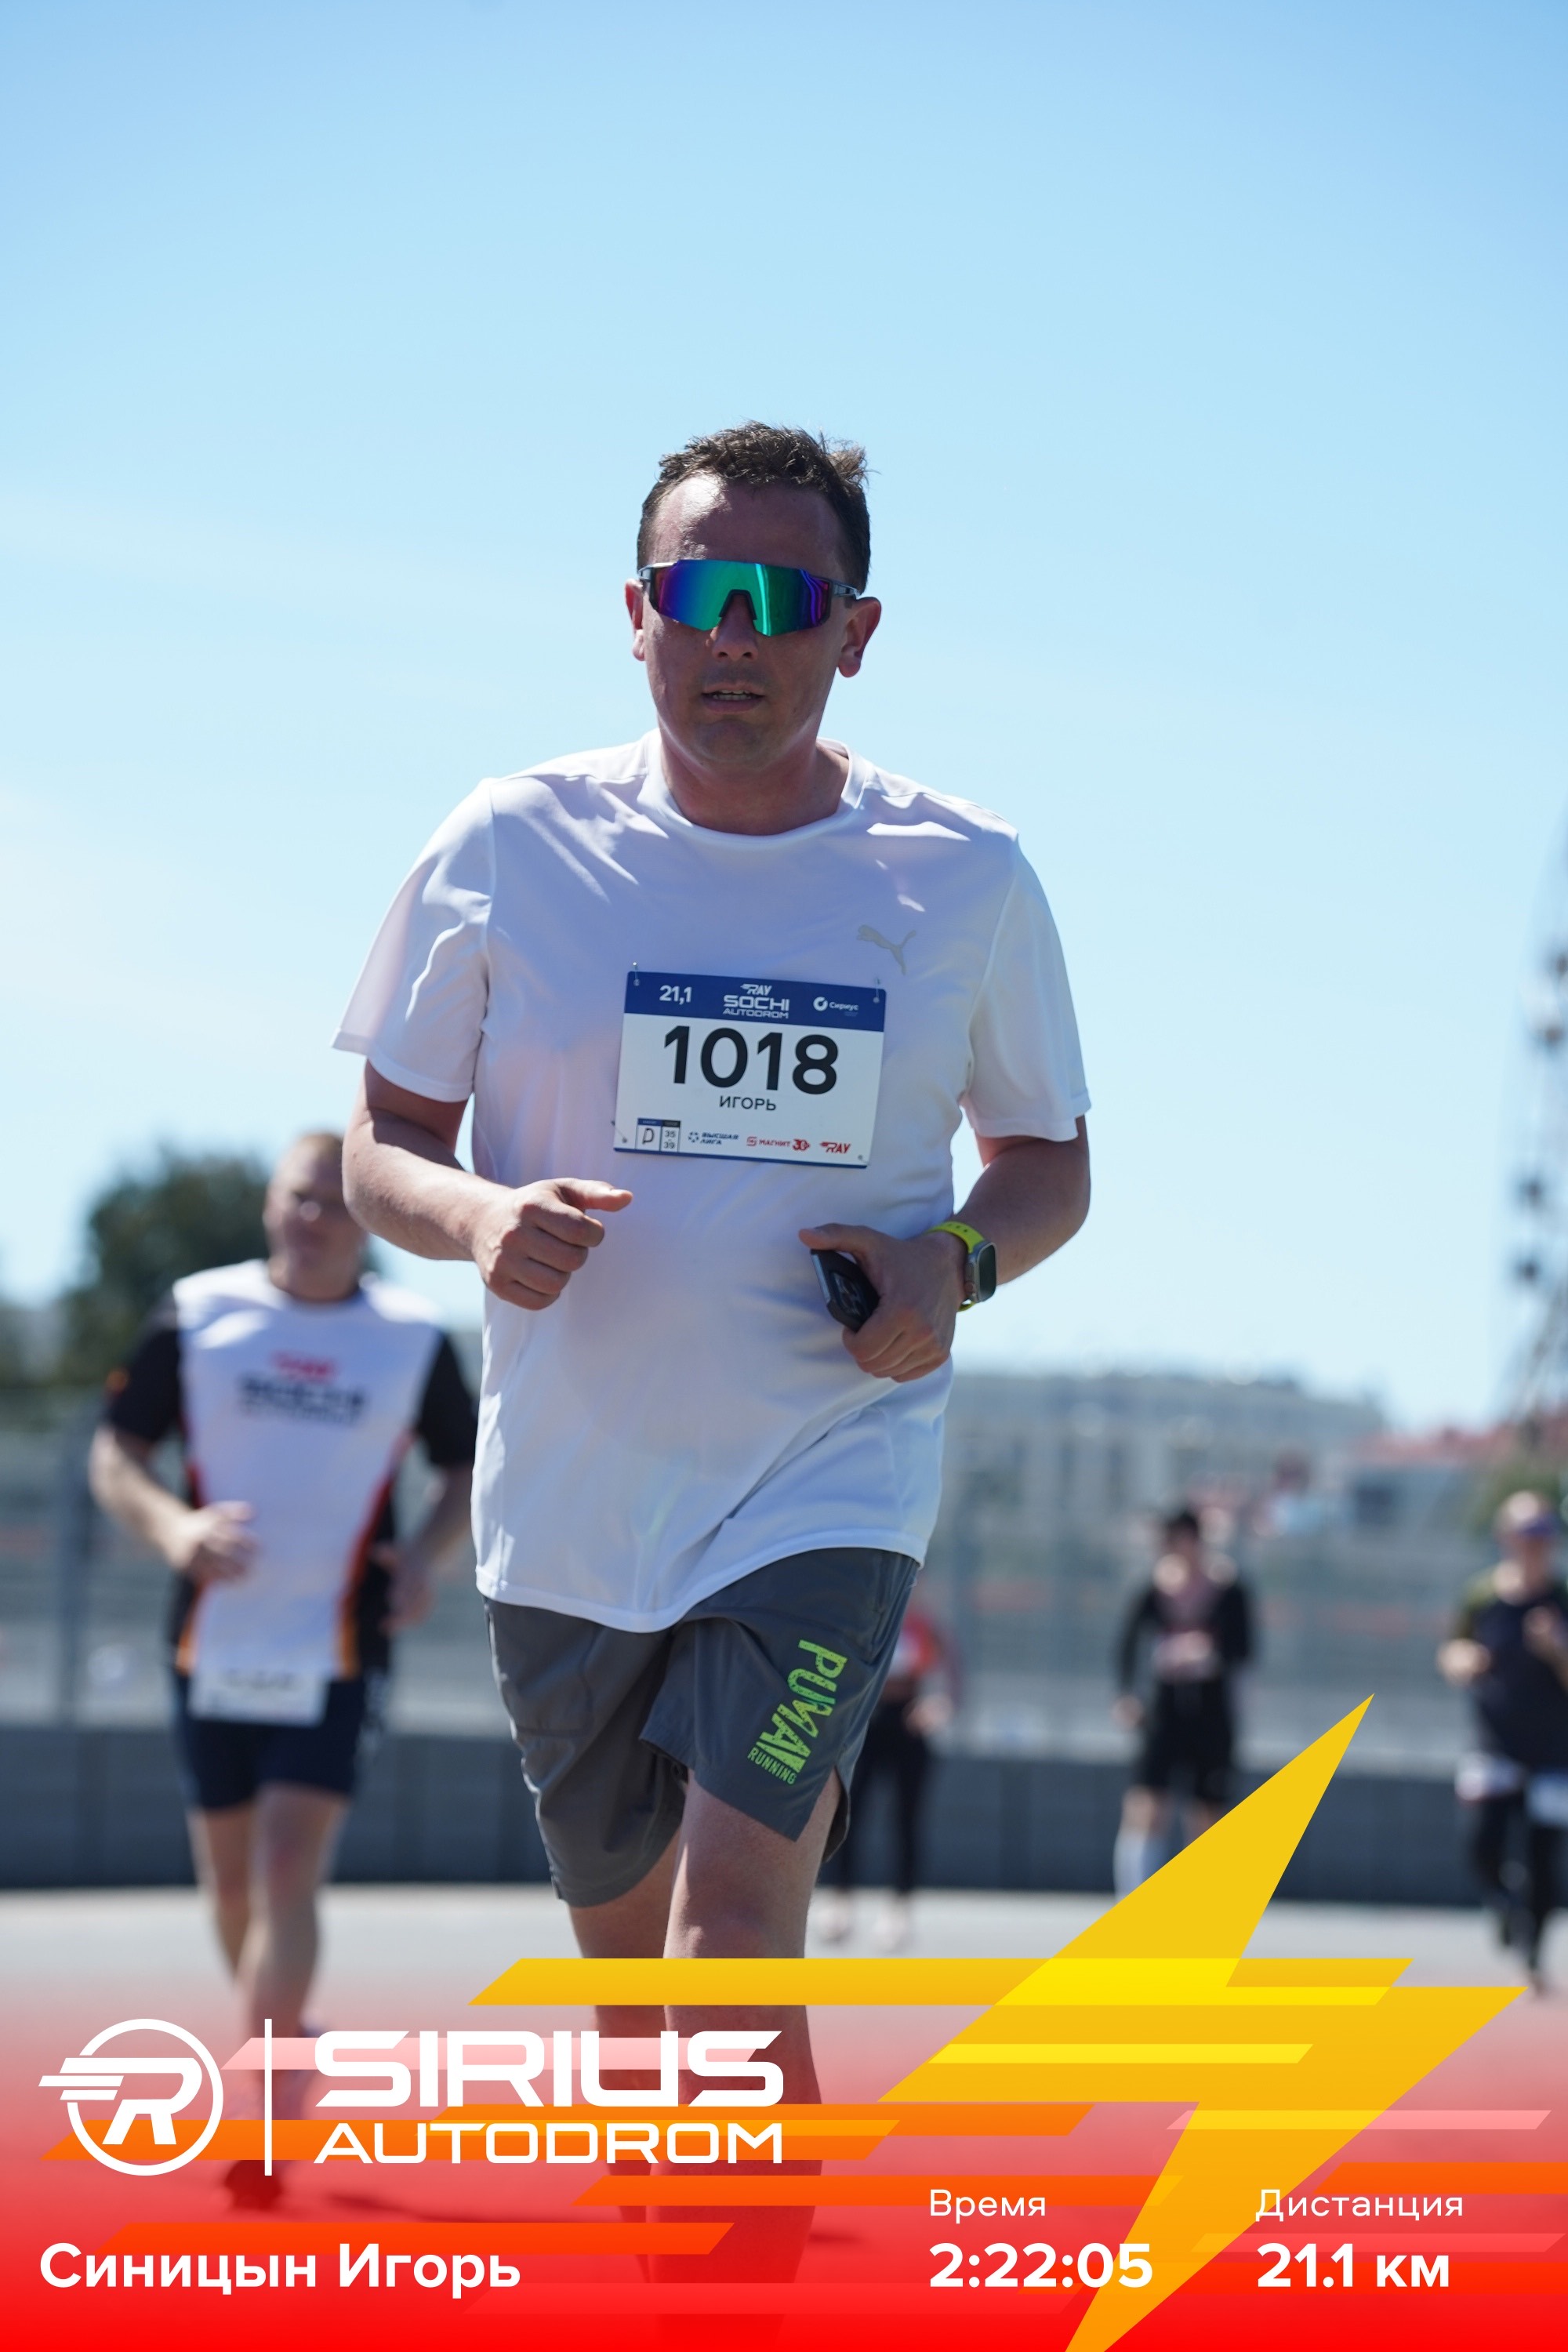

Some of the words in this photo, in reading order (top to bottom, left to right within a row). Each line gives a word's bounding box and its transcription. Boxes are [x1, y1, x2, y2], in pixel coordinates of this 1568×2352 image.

[659, 985, 692, 1005] 21,1
[740, 983, 772, 996] RAY
[723, 994, 790, 1011] SOCHI
[829, 1001, 859, 1011] Сириус
[723, 1007, 789, 1019] AUTODROM
[664, 1025, 839, 1094] 1018
[719, 1095, 776, 1111] ИГОРЬ
[701, 1131, 739, 1141] ВЫСШАЯ
[759, 1138, 790, 1147] МАГНИТ
[820, 1142, 851, 1154] RAY
[759, 1639, 848, 1759] PUMA
[747, 1747, 797, 1784] RUNNING
